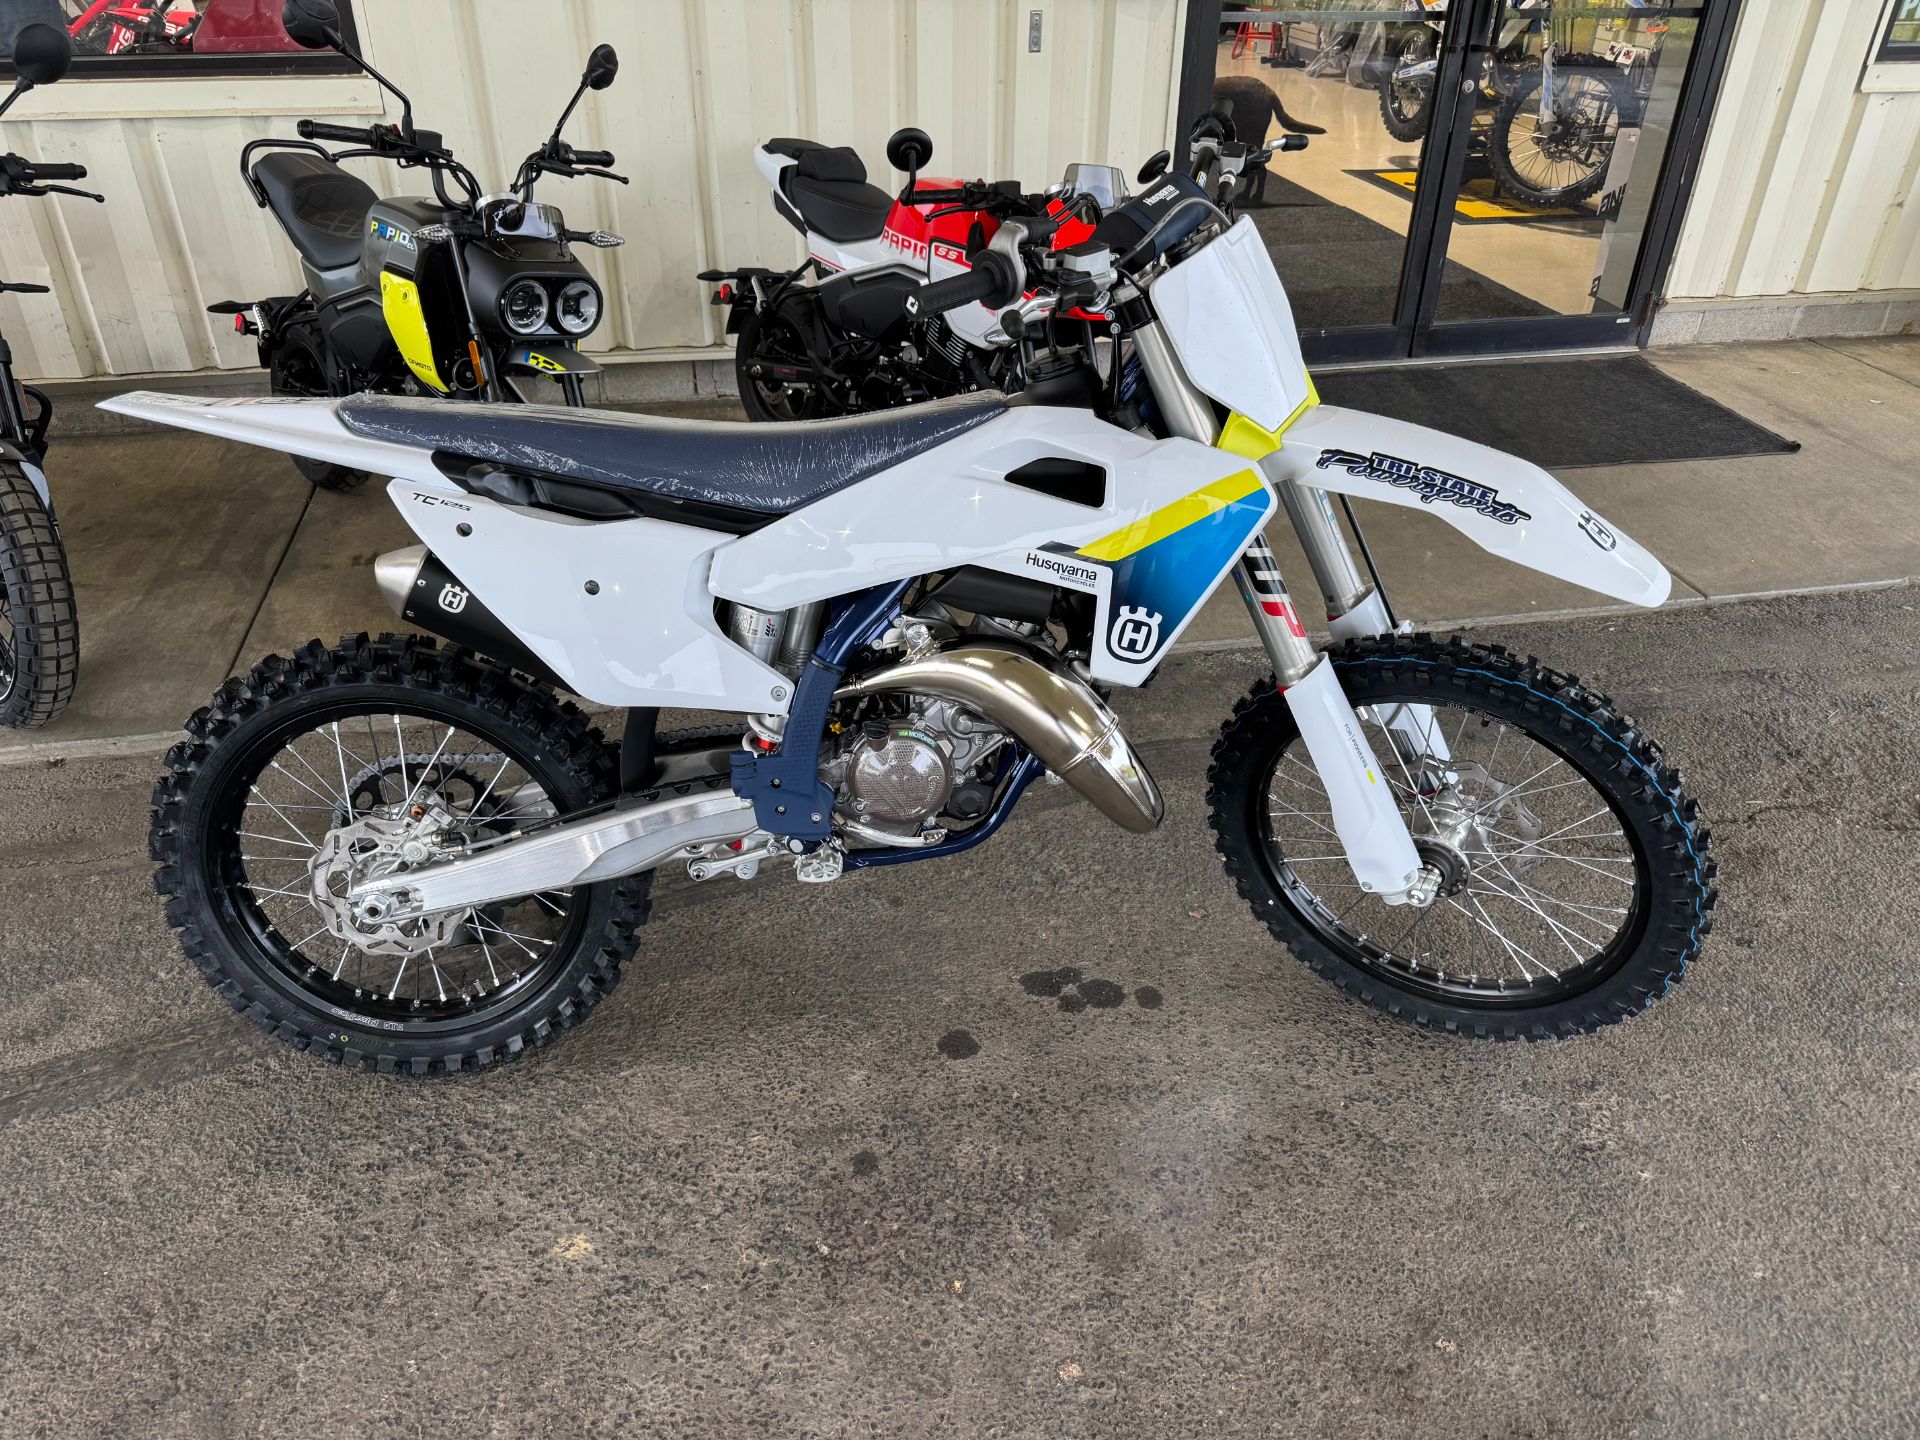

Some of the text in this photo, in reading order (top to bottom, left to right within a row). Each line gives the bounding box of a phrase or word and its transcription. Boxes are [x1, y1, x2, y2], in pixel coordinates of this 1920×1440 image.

[371, 220, 410, 245] PAPIO
[880, 229, 928, 261] PAPIO
[936, 247, 959, 260] SS
[1316, 449, 1532, 525] Powersports
[1372, 454, 1496, 503] TRI-STATE
[413, 492, 472, 511] TC 125
[1025, 552, 1098, 582] Husqvarna
[1059, 575, 1096, 588] MOTORCYCLES
